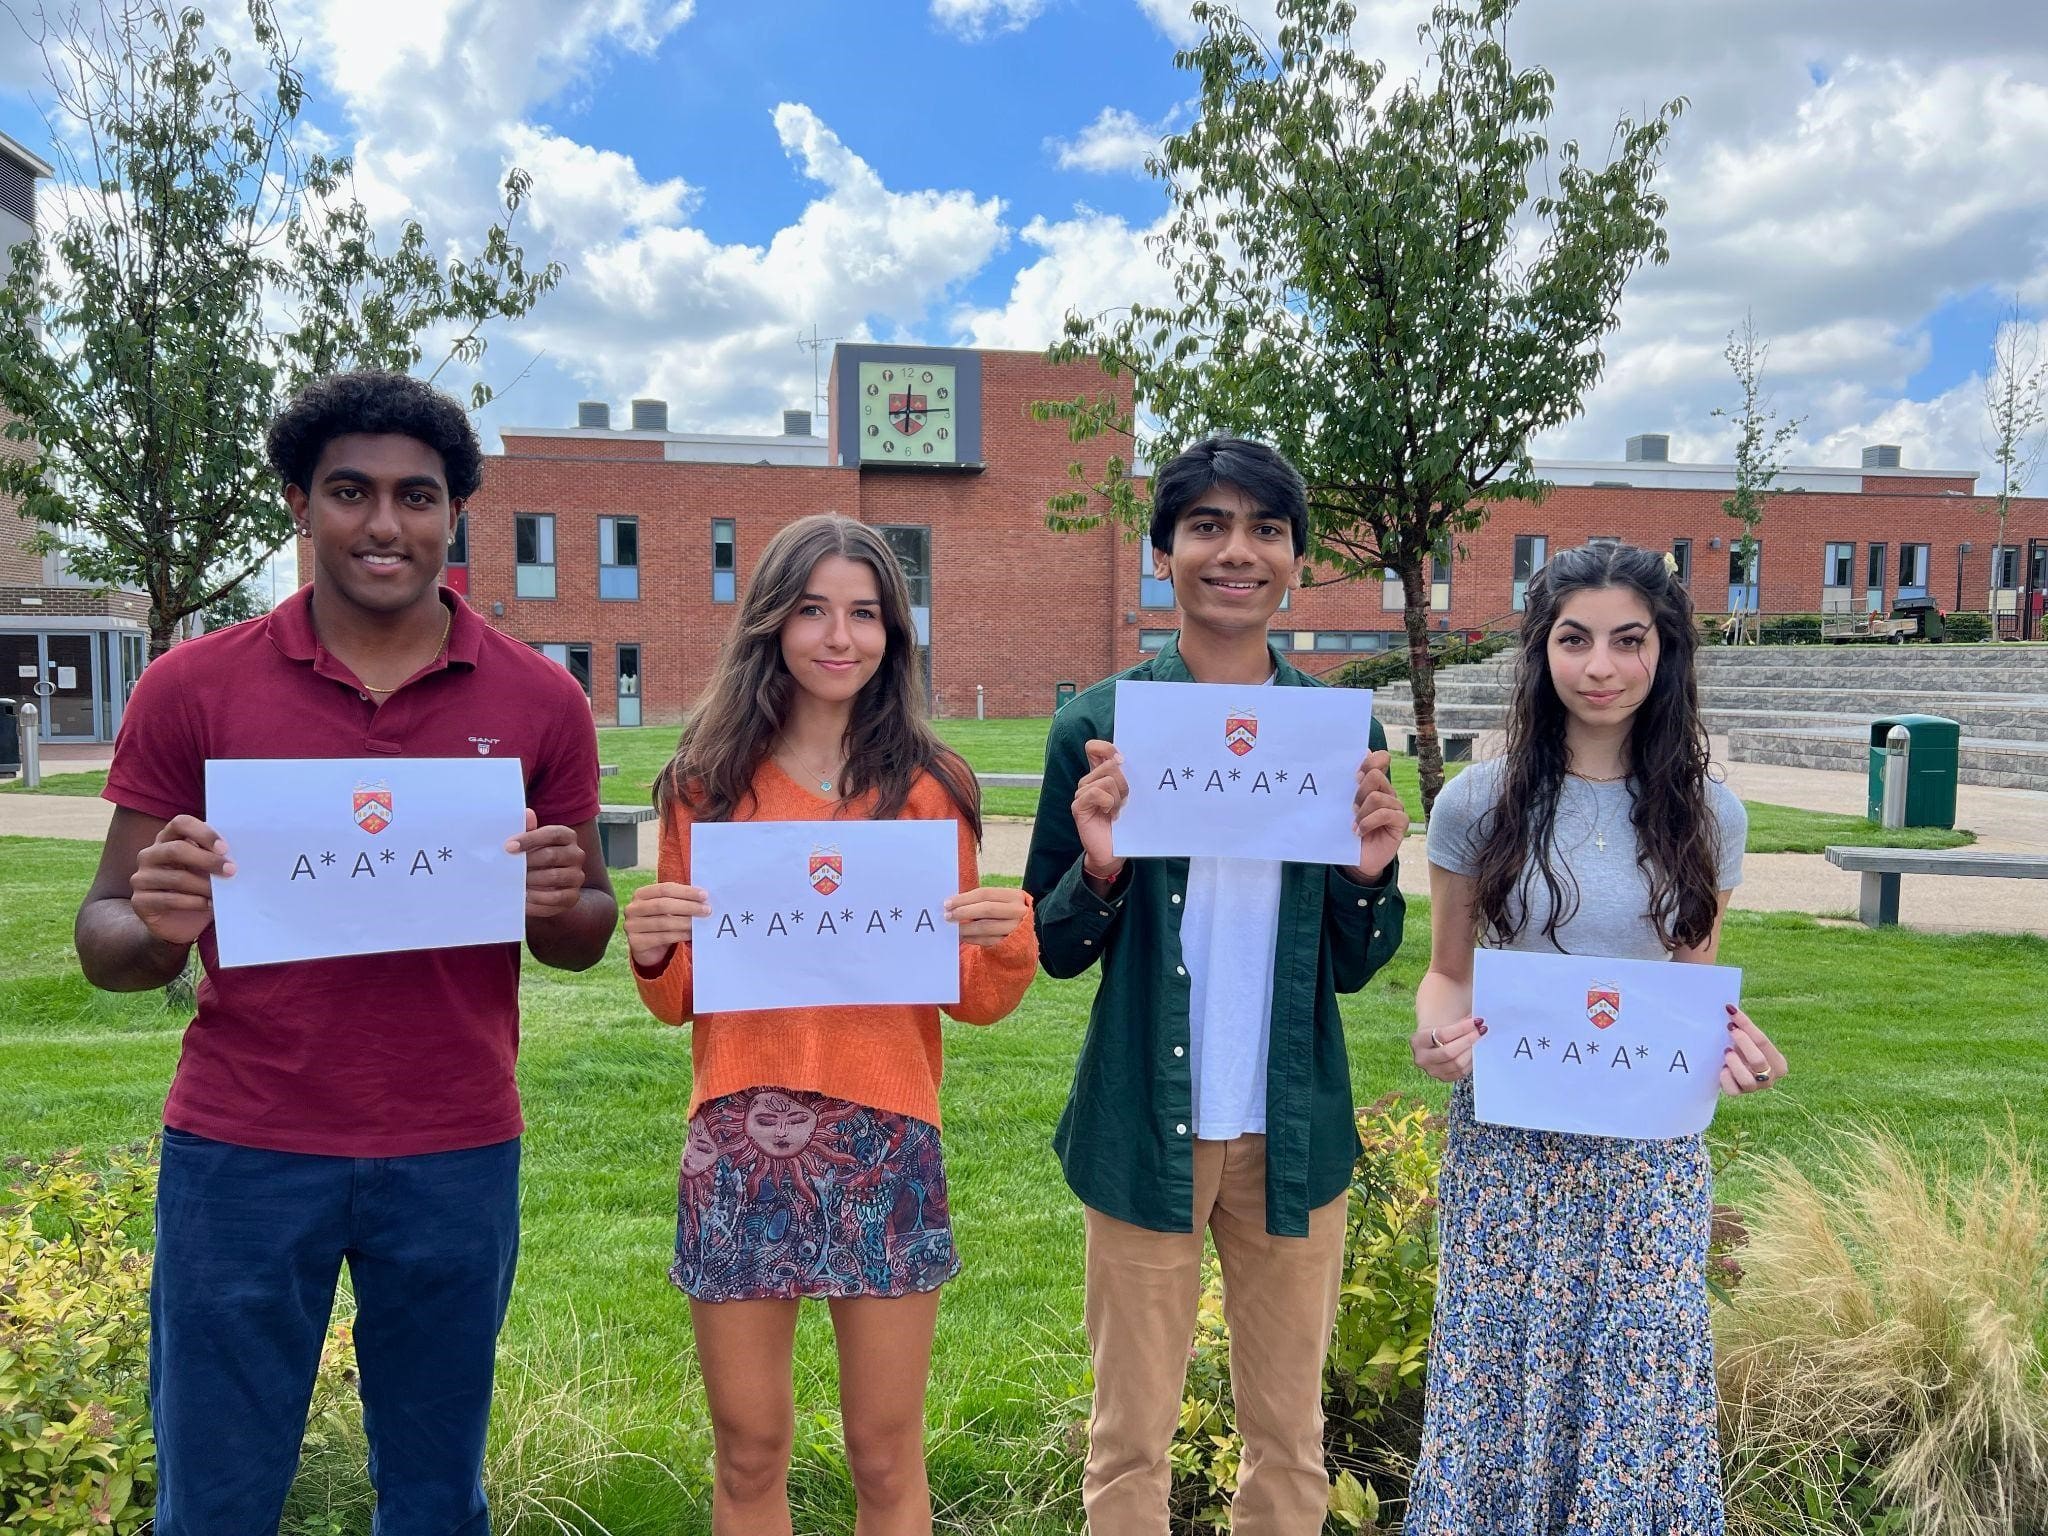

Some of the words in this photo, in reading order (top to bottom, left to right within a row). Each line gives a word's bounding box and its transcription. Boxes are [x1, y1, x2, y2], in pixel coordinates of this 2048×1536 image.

[902, 368, 914, 378] 12
[865, 405, 872, 415] 9
[905, 447, 912, 457] 6
[468, 736, 501, 744] GANT
[1297, 772, 1318, 796] A
[914, 908, 935, 933] A
[1668, 1049, 1689, 1074] A
